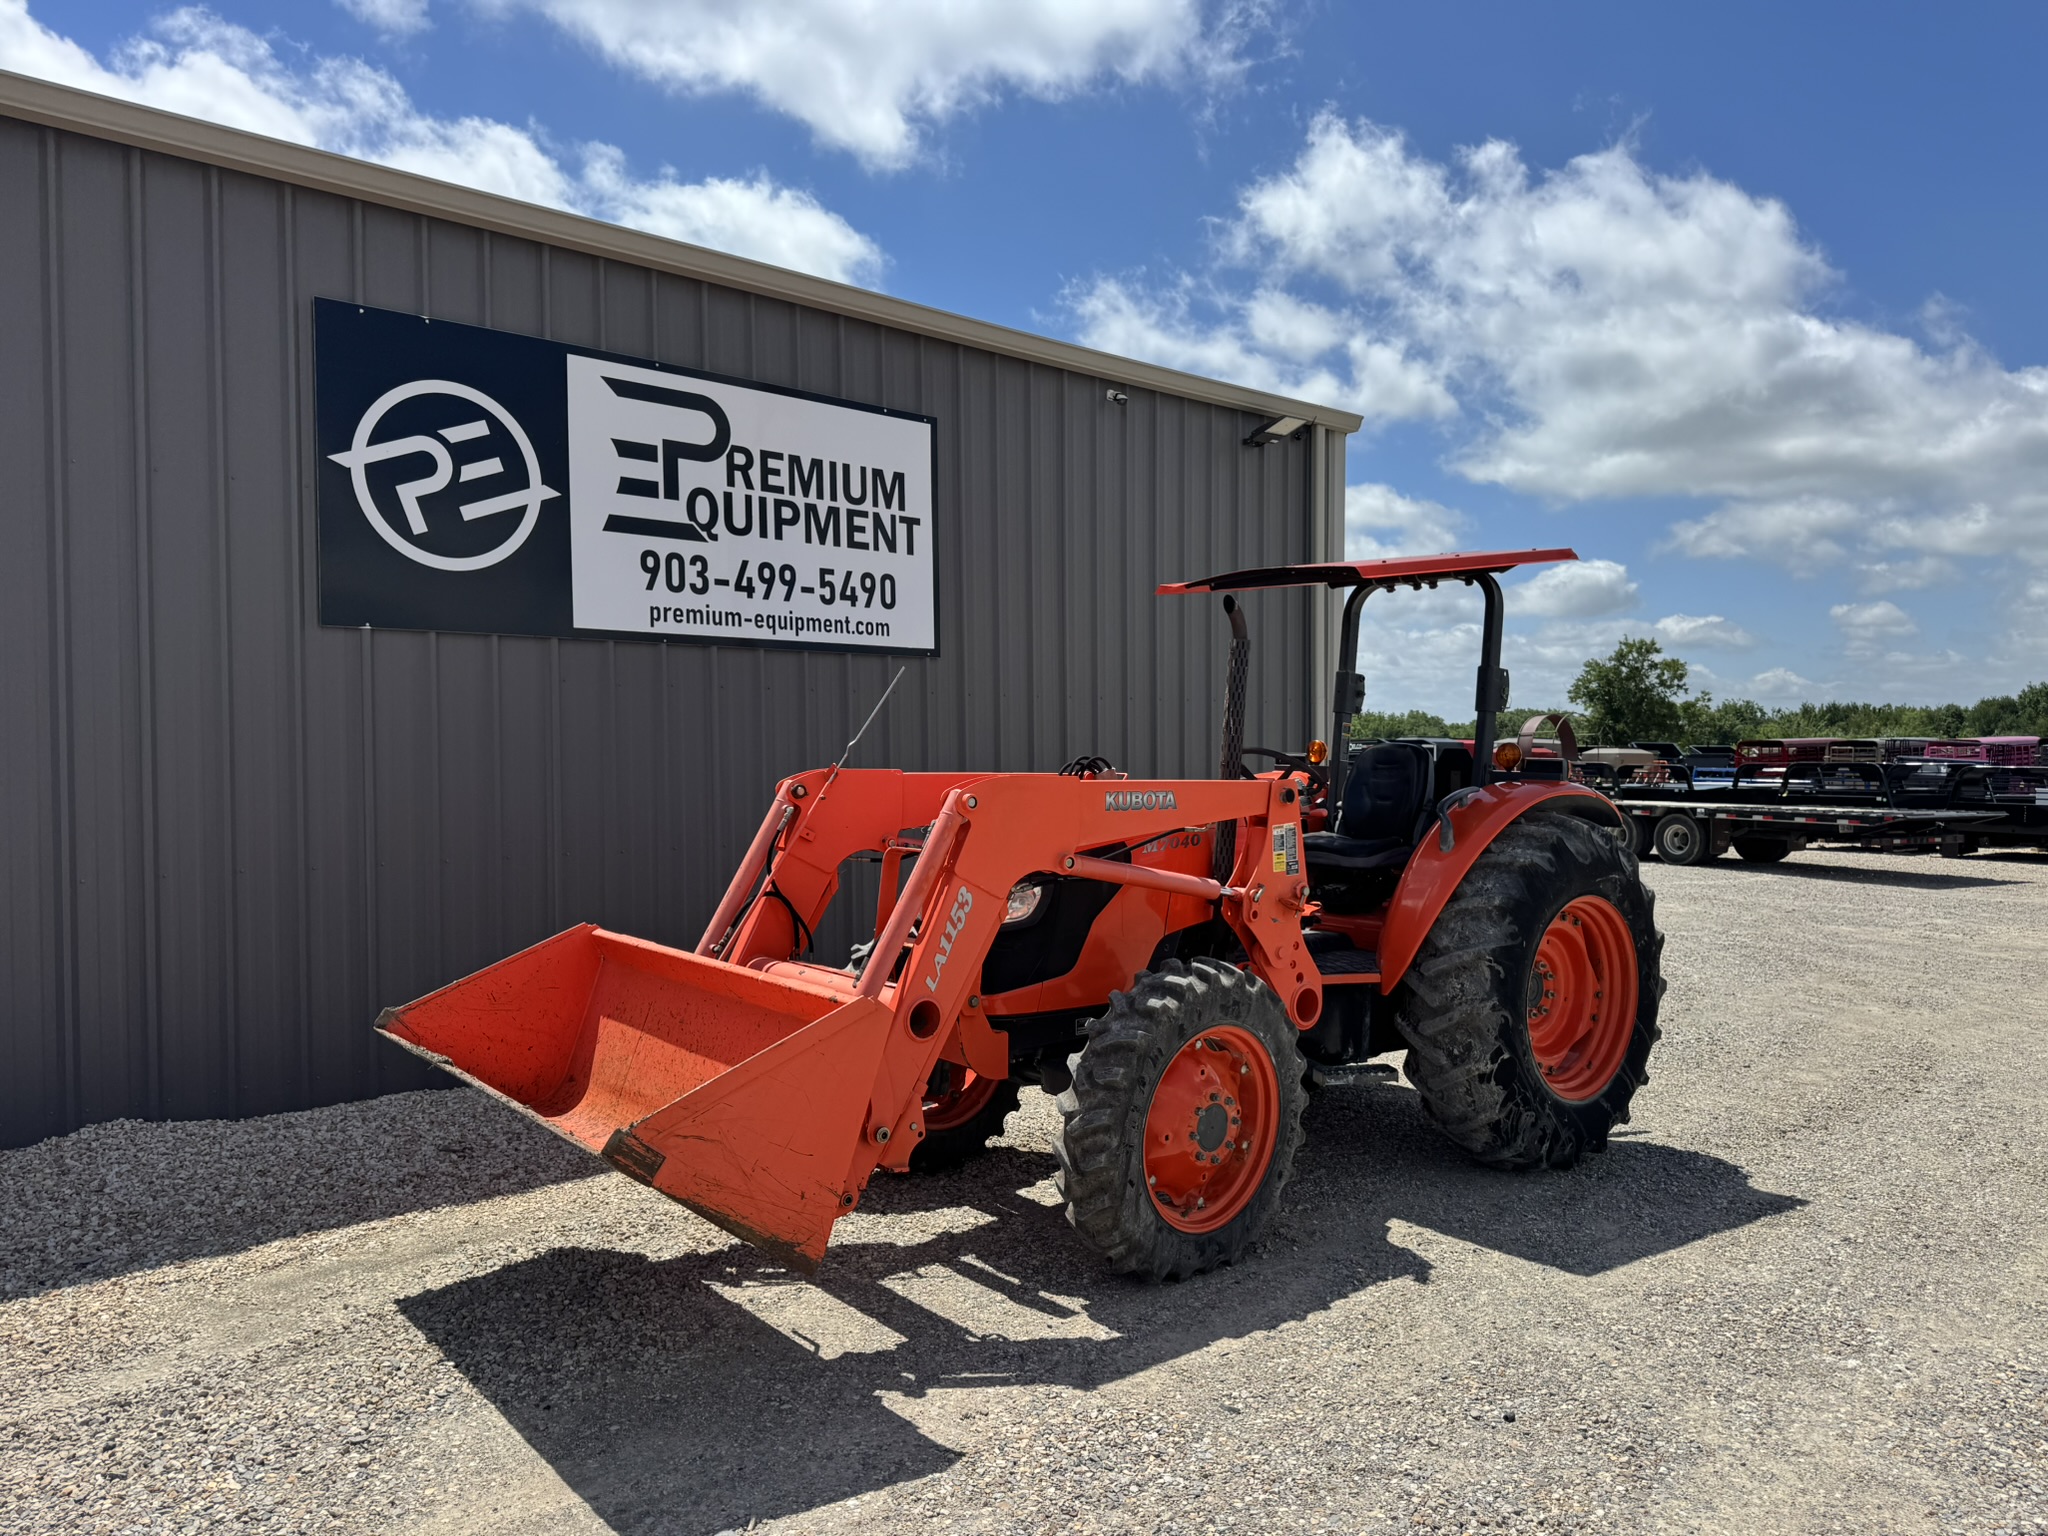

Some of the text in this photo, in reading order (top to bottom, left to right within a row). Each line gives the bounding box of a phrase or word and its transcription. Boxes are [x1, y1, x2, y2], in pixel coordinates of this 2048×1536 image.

[640, 549, 897, 610] 903-499-5490
[649, 604, 891, 637] premium-equipment.com
[1105, 790, 1178, 811] KUBOTA
[1142, 834, 1202, 854] M7040
[925, 885, 974, 993] LA1153
